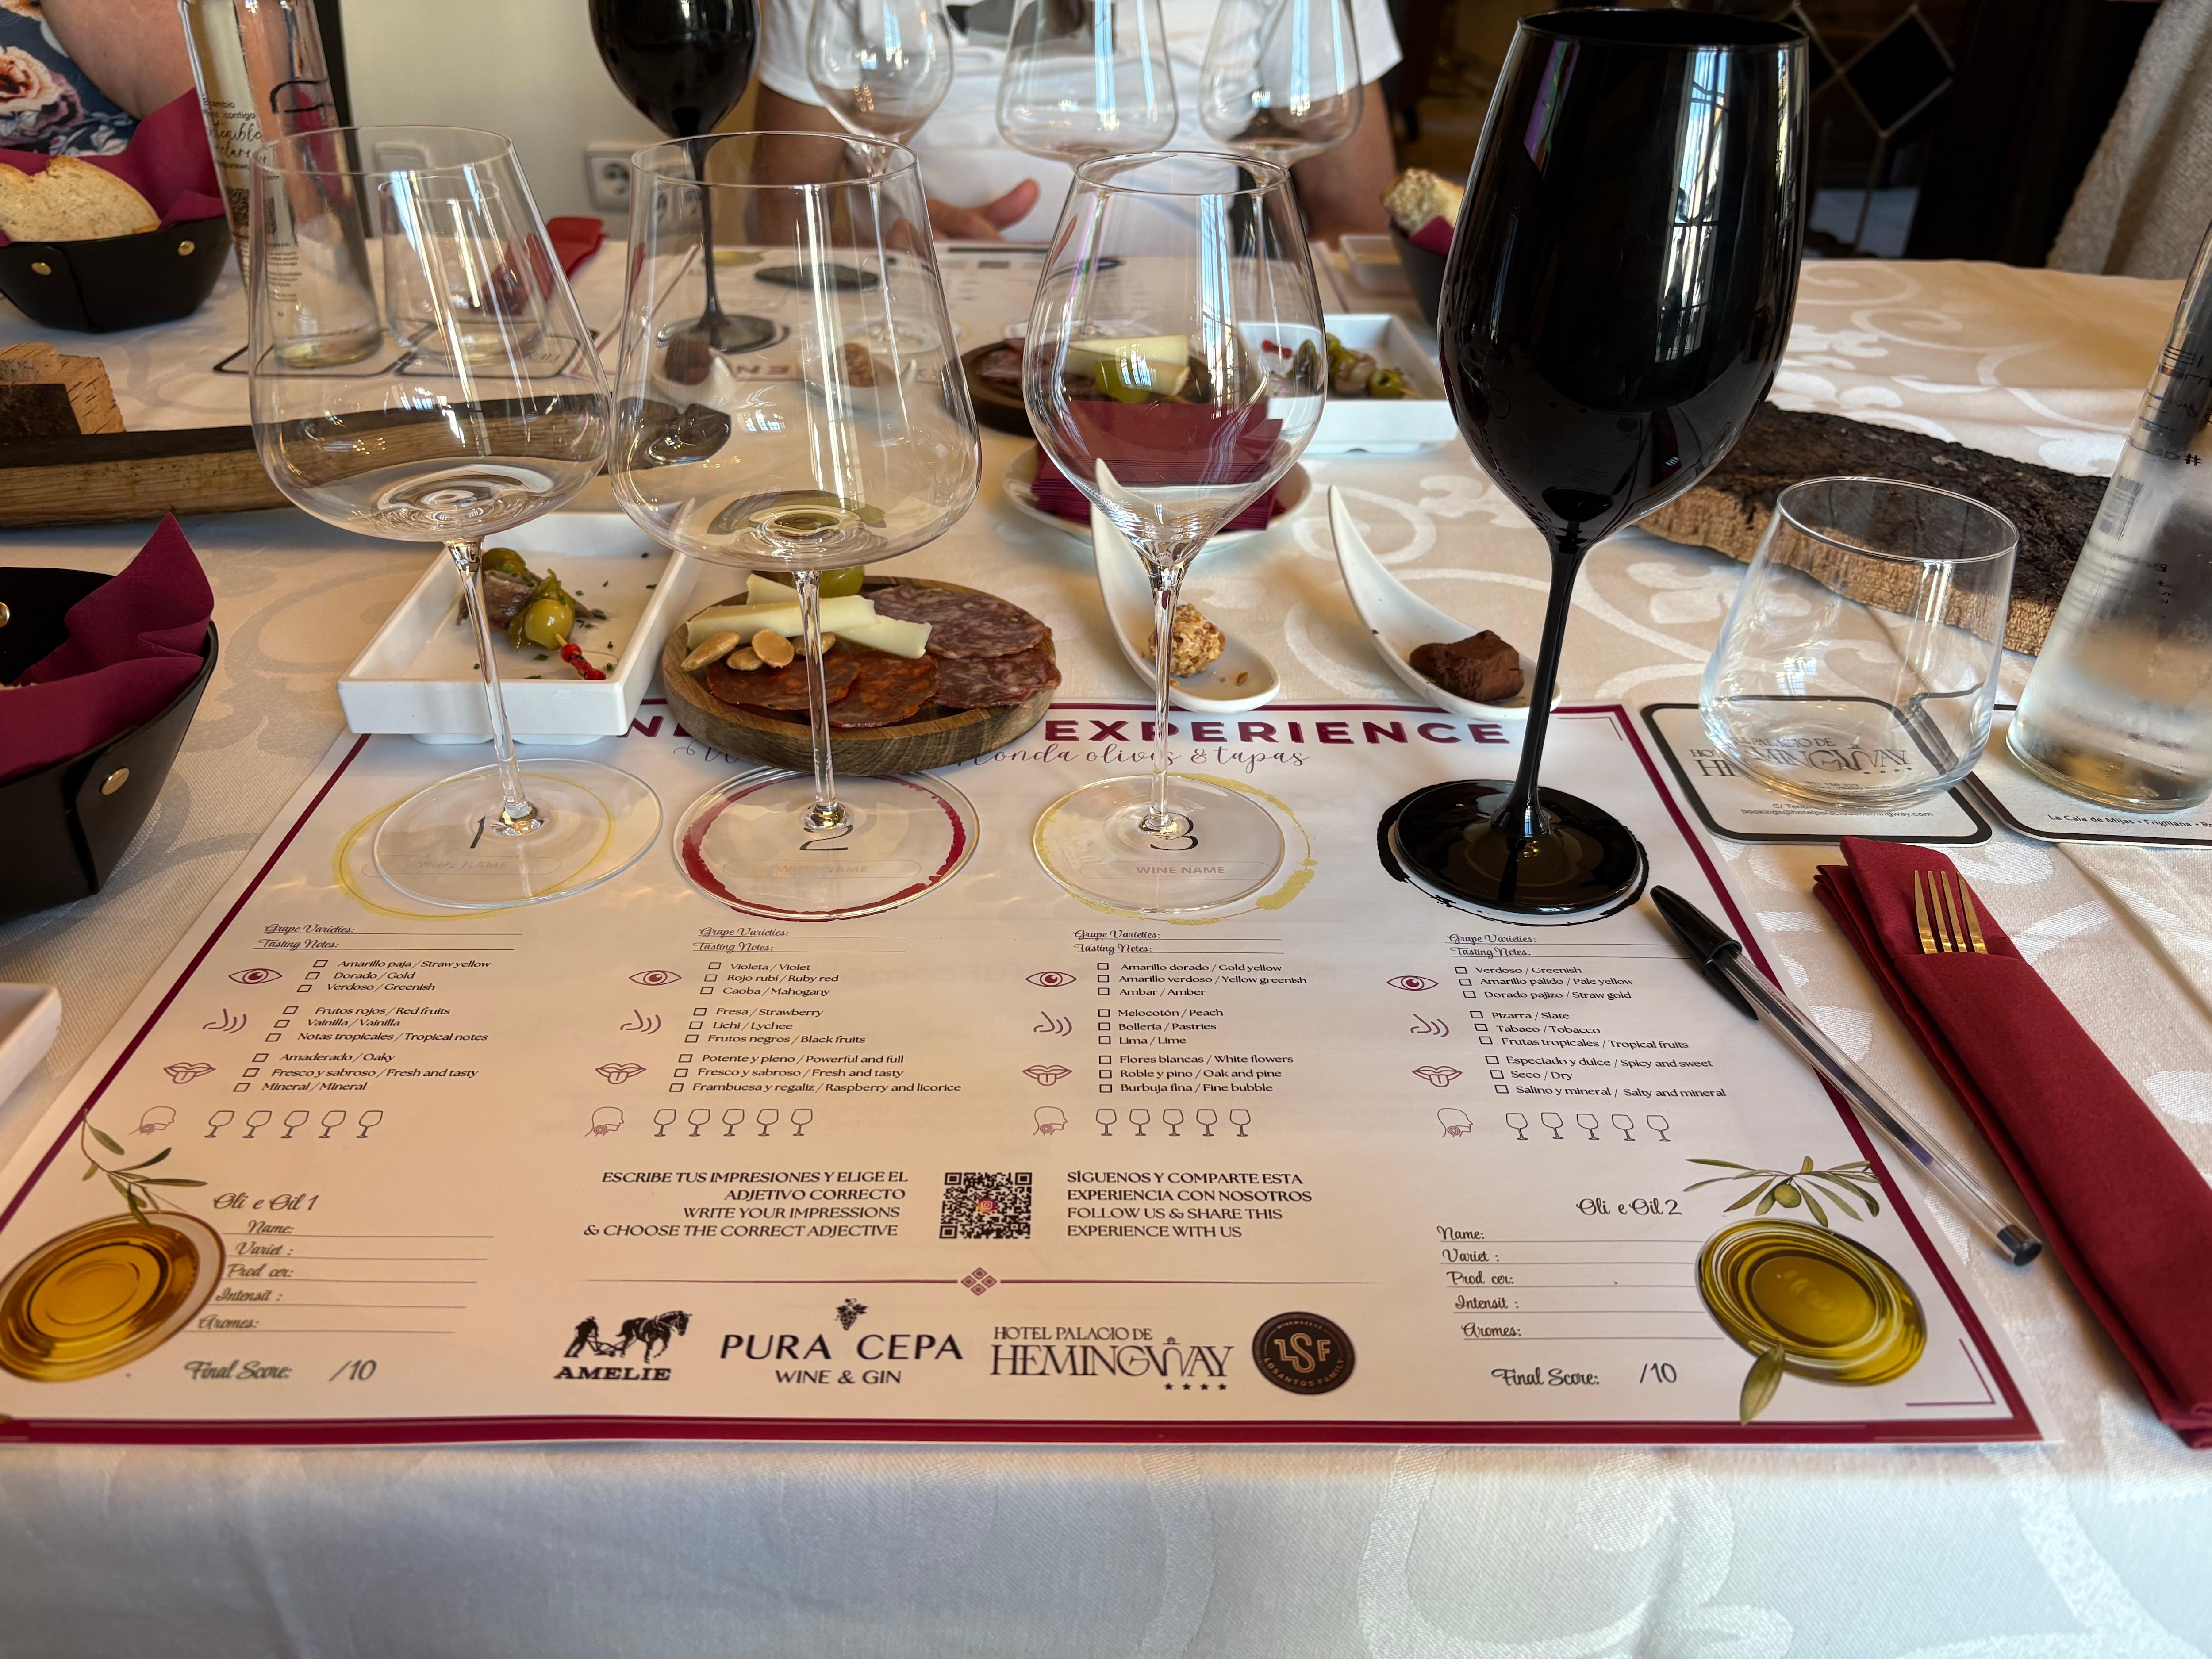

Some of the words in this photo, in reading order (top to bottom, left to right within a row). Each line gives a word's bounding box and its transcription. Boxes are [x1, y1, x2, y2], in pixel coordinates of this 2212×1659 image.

[1045, 720, 1510, 745] EXPERIENCE
[958, 743, 1078, 767] onda
[1190, 748, 1207, 764] &
[1214, 744, 1310, 774] tapas
[470, 816, 485, 849] 1
[1144, 811, 1198, 850] 3
[799, 824, 853, 851] 2
[1181, 865, 1225, 874] NAME
[265, 924, 300, 934] Grape
[303, 924, 355, 933] Varieties:
[699, 927, 734, 938] Grape
[738, 927, 788, 937] Varieties:
[1073, 930, 1107, 940] Grape
[1110, 930, 1161, 939] Varieties:
[258, 939, 301, 949] Tasting
[303, 939, 339, 949] Notes:
[1447, 933, 1482, 945] Grape
[1484, 934, 1536, 943] Varieties:
[693, 942, 736, 953] Tasting
[738, 942, 774, 951] Notes:
[1074, 943, 1115, 955] Tasting
[1118, 943, 1152, 953] Notes:
[1450, 947, 1494, 959] Tasting
[1495, 947, 1531, 956] Notes:
[388, 961, 411, 969] paja
[452, 961, 491, 969] yellow
[727, 975, 752, 983] Rojo
[754, 974, 778, 982] rubí
[787, 975, 816, 984] Ruby
[1260, 976, 1307, 985] greenish
[771, 987, 830, 997] Mahogany
[1530, 991, 1563, 1001] pajizo
[1606, 991, 1632, 1001] gold
[758, 1008, 823, 1017] Strawberry
[307, 1018, 348, 1027] Vainilla
[358, 1018, 400, 1027] Vainilla
[751, 1022, 793, 1031] Lychee
[1549, 1026, 1601, 1034] Tobacco
[1511, 1071, 1541, 1079] Seco
[1551, 1071, 1572, 1080] Dry
[262, 1082, 309, 1091] Mineral
[319, 1082, 367, 1091] Mineral
[602, 1172, 672, 1183] ESCRIBE
[676, 1172, 707, 1183] TUS
[710, 1172, 820, 1183] IMPRESIONES
[824, 1172, 835, 1182] Y
[837, 1172, 886, 1182] ELIGE
[888, 1172, 908, 1182] EL
[1067, 1169, 1151, 1184] SÍGUENOS
[1154, 1173, 1165, 1183] Y
[1167, 1172, 1259, 1184] COMPARTE
[1262, 1173, 1303, 1185] ESTA
[724, 1190, 806, 1202] ADJETIVO
[809, 1189, 905, 1200] CORRECTO
[1068, 1190, 1174, 1201] EXPERIENCIA
[1177, 1190, 1215, 1201] CON
[1219, 1190, 1312, 1202] NOSOTROS
[307, 1195, 319, 1210] 1
[1665, 1201, 1682, 1215] 2
[684, 1208, 735, 1218] WRITE
[739, 1207, 787, 1218] YOUR
[789, 1207, 900, 1218] IMPRESSIONS
[1068, 1208, 1140, 1219] FOLLOW
[1144, 1208, 1166, 1219] US
[1169, 1208, 1185, 1220] &
[1187, 1208, 1242, 1219] SHARE
[1246, 1209, 1283, 1220] THIS
[248, 1220, 293, 1233] Name:
[584, 1225, 600, 1236] &
[603, 1225, 680, 1236] CHOOSE
[684, 1225, 718, 1236] THE
[720, 1225, 805, 1236] CORRECT
[806, 1225, 898, 1237] ADJECTIVE
[1068, 1225, 1169, 1237] EXPERIENCE
[1172, 1226, 1218, 1237] WITH
[1221, 1226, 1242, 1237] US
[1436, 1225, 1485, 1240] Name:
[1442, 1249, 1489, 1262] Variet
[1447, 1271, 1485, 1285] Prod
[1491, 1275, 1514, 1285] cer:
[1455, 1295, 1509, 1309] Intensit
[994, 1327, 1052, 1340] HOTEL
[1055, 1327, 1129, 1340] PALACIO
[1133, 1328, 1152, 1340] DE
[1461, 1322, 1522, 1337] Aromes:
[720, 1334, 832, 1359] PURA
[856, 1335, 964, 1359] CEPA
[990, 1345, 1234, 1376] HEMINGWAY
[184, 1360, 238, 1380] Final
[237, 1360, 292, 1379] Score:
[554, 1366, 672, 1381] AMELIE
[775, 1370, 831, 1384] WINE
[837, 1370, 856, 1384] &
[862, 1370, 901, 1384] GIN
[1491, 1368, 1544, 1385] Final
[1548, 1369, 1600, 1386] Score:
